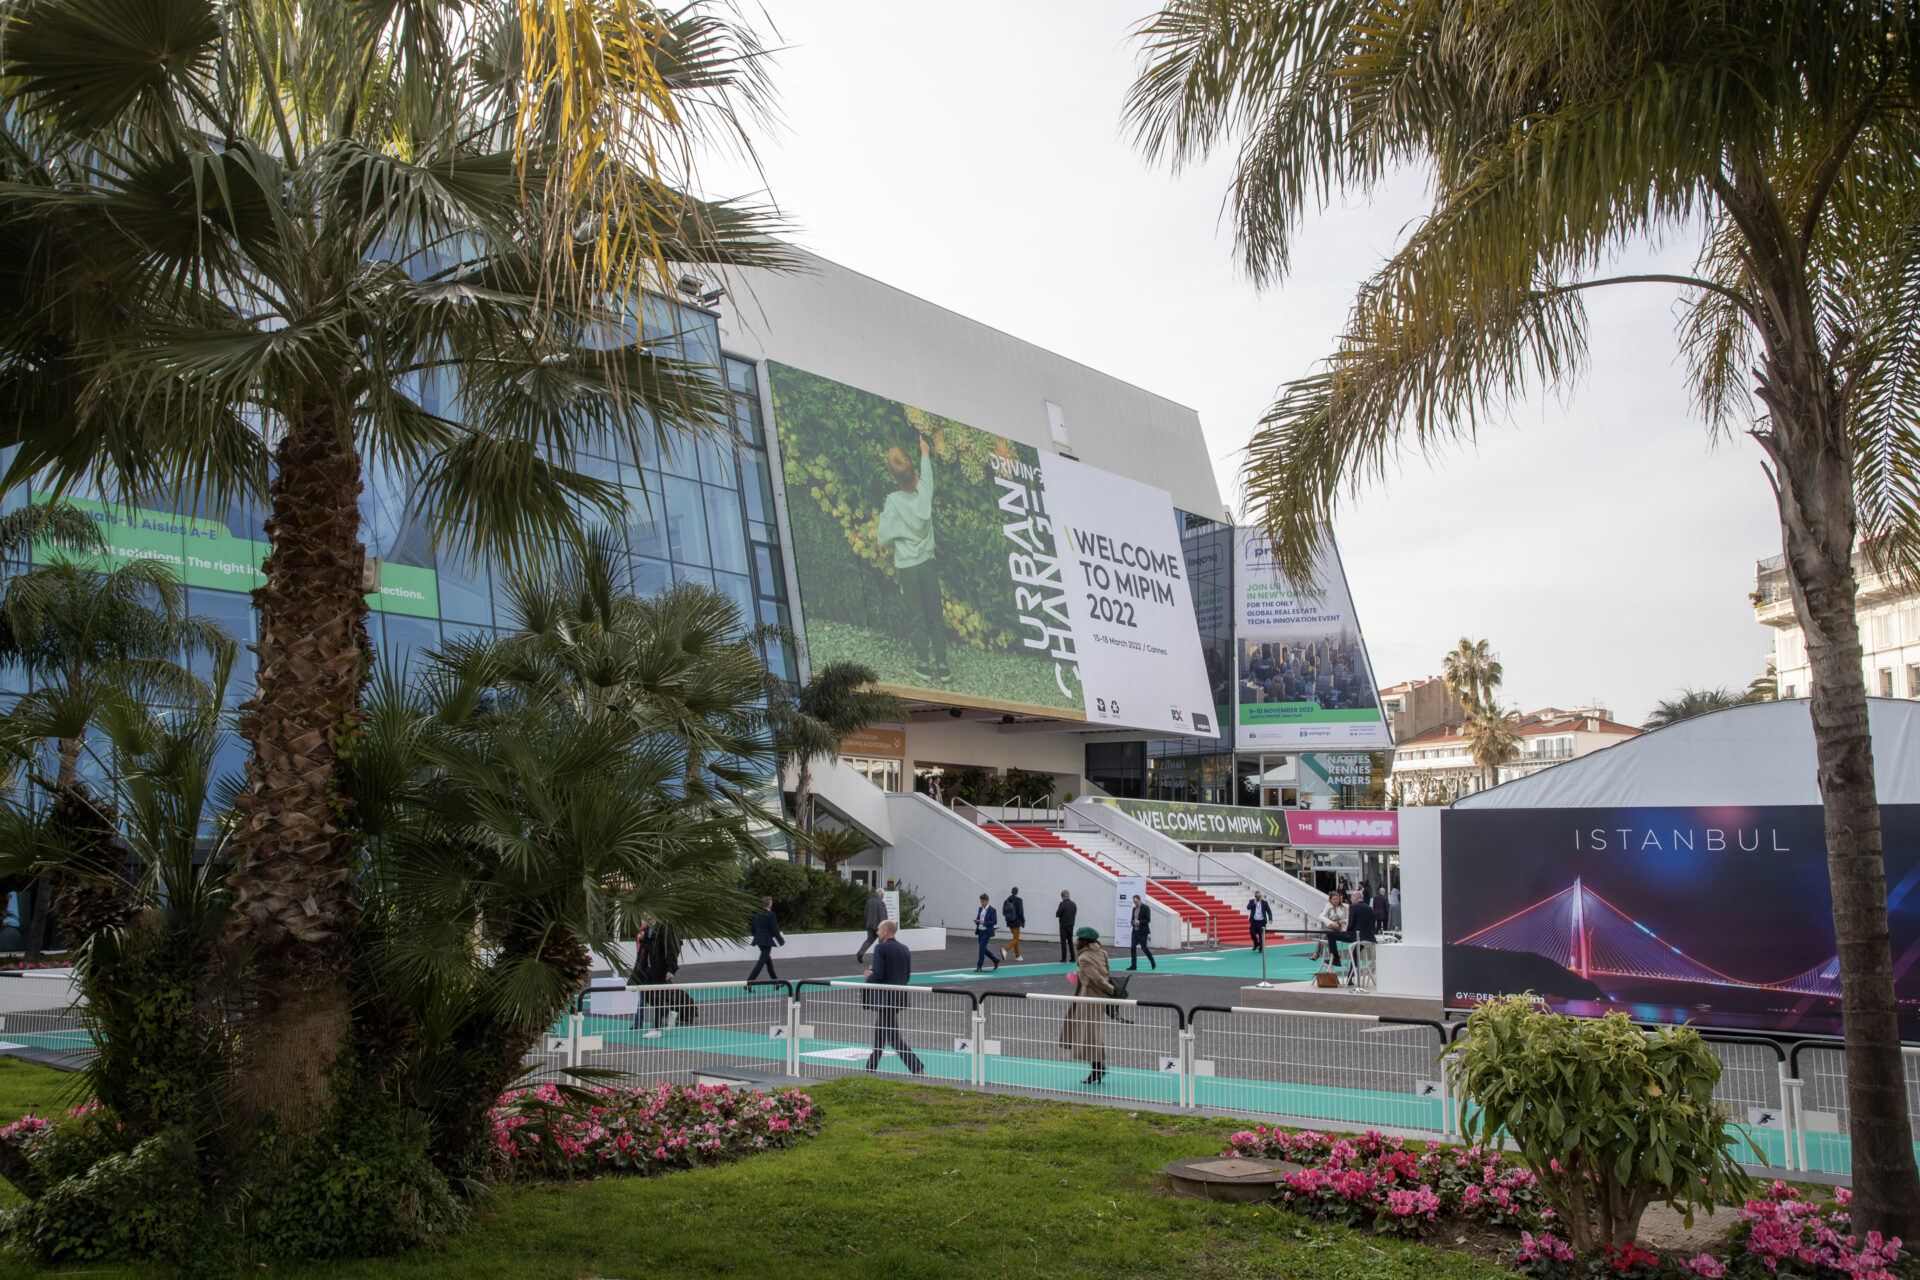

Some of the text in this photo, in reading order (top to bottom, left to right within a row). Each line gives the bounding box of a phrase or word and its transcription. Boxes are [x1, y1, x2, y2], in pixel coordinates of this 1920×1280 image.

[141, 518, 186, 536] Aisles
[119, 547, 185, 566] solutions.
[187, 556, 211, 569] The
[213, 560, 244, 575] right
[994, 476, 1049, 650] URBAN
[1073, 528, 1181, 580] WELCOME
[1079, 560, 1175, 607] TO MIPIM
[1247, 583, 1268, 591] JOIN
[1247, 592, 1256, 600] IN
[1257, 591, 1279, 599] NEW
[1086, 593, 1137, 628] 2022
[1273, 616, 1317, 624] INNOVATION
[1318, 614, 1341, 622] EVENT
[1292, 607, 1317, 615] ESTATE
[1109, 637, 1128, 648] March
[1128, 640, 1142, 651] 2022
[1146, 644, 1168, 656] Cannes
[1327, 755, 1371, 764] NANTES
[1328, 765, 1371, 775] RENNES
[1326, 775, 1371, 785] ANGERS
[1137, 810, 1263, 834] WELCOME TO MIPIM
[1298, 819, 1393, 836] THE IMPACT
[1575, 829, 1790, 851] ISTANBUL
